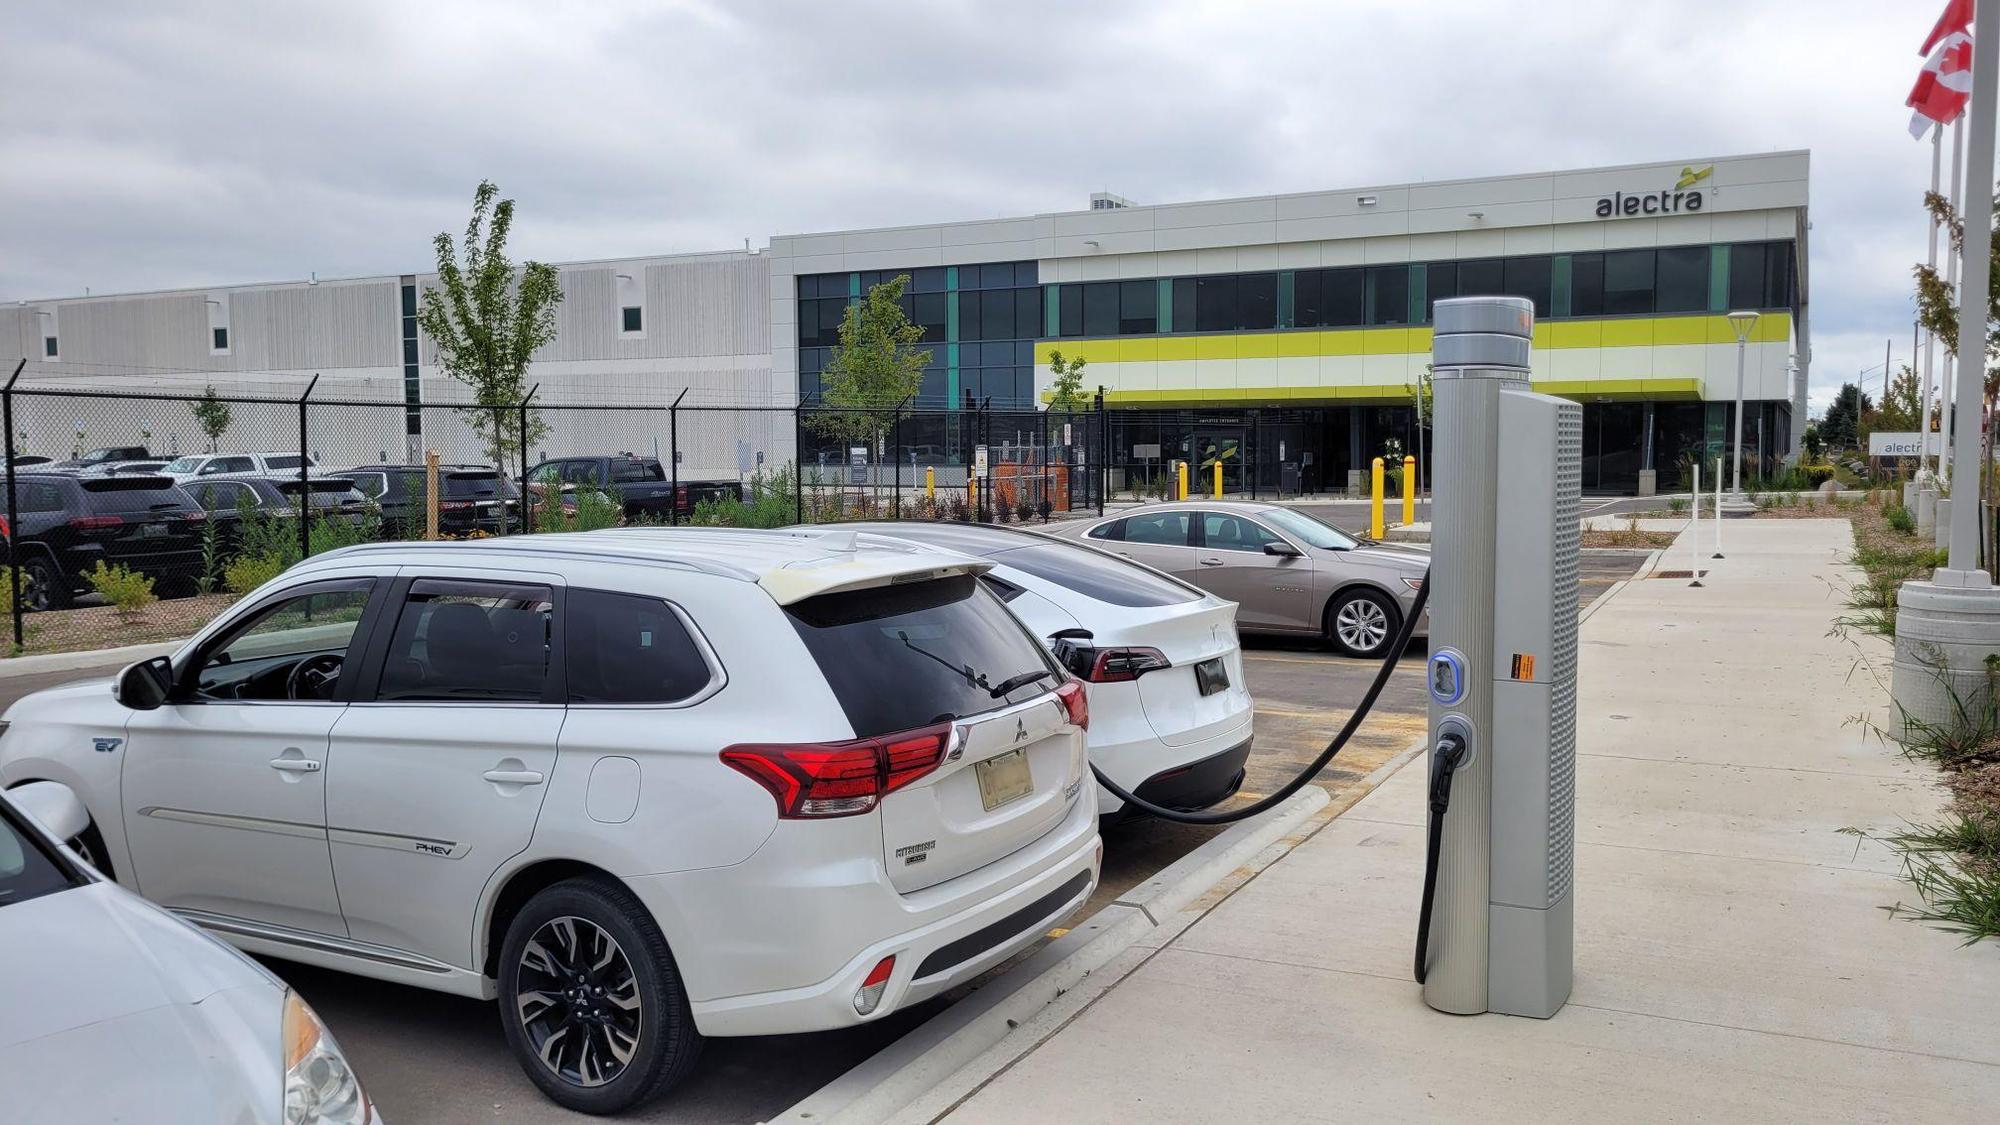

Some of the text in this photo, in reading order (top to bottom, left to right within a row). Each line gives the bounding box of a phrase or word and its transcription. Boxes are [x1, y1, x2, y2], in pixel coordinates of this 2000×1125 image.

[1596, 190, 1702, 217] alectra
[1884, 442, 1922, 453] alectr
[416, 842, 452, 855] PHEV
